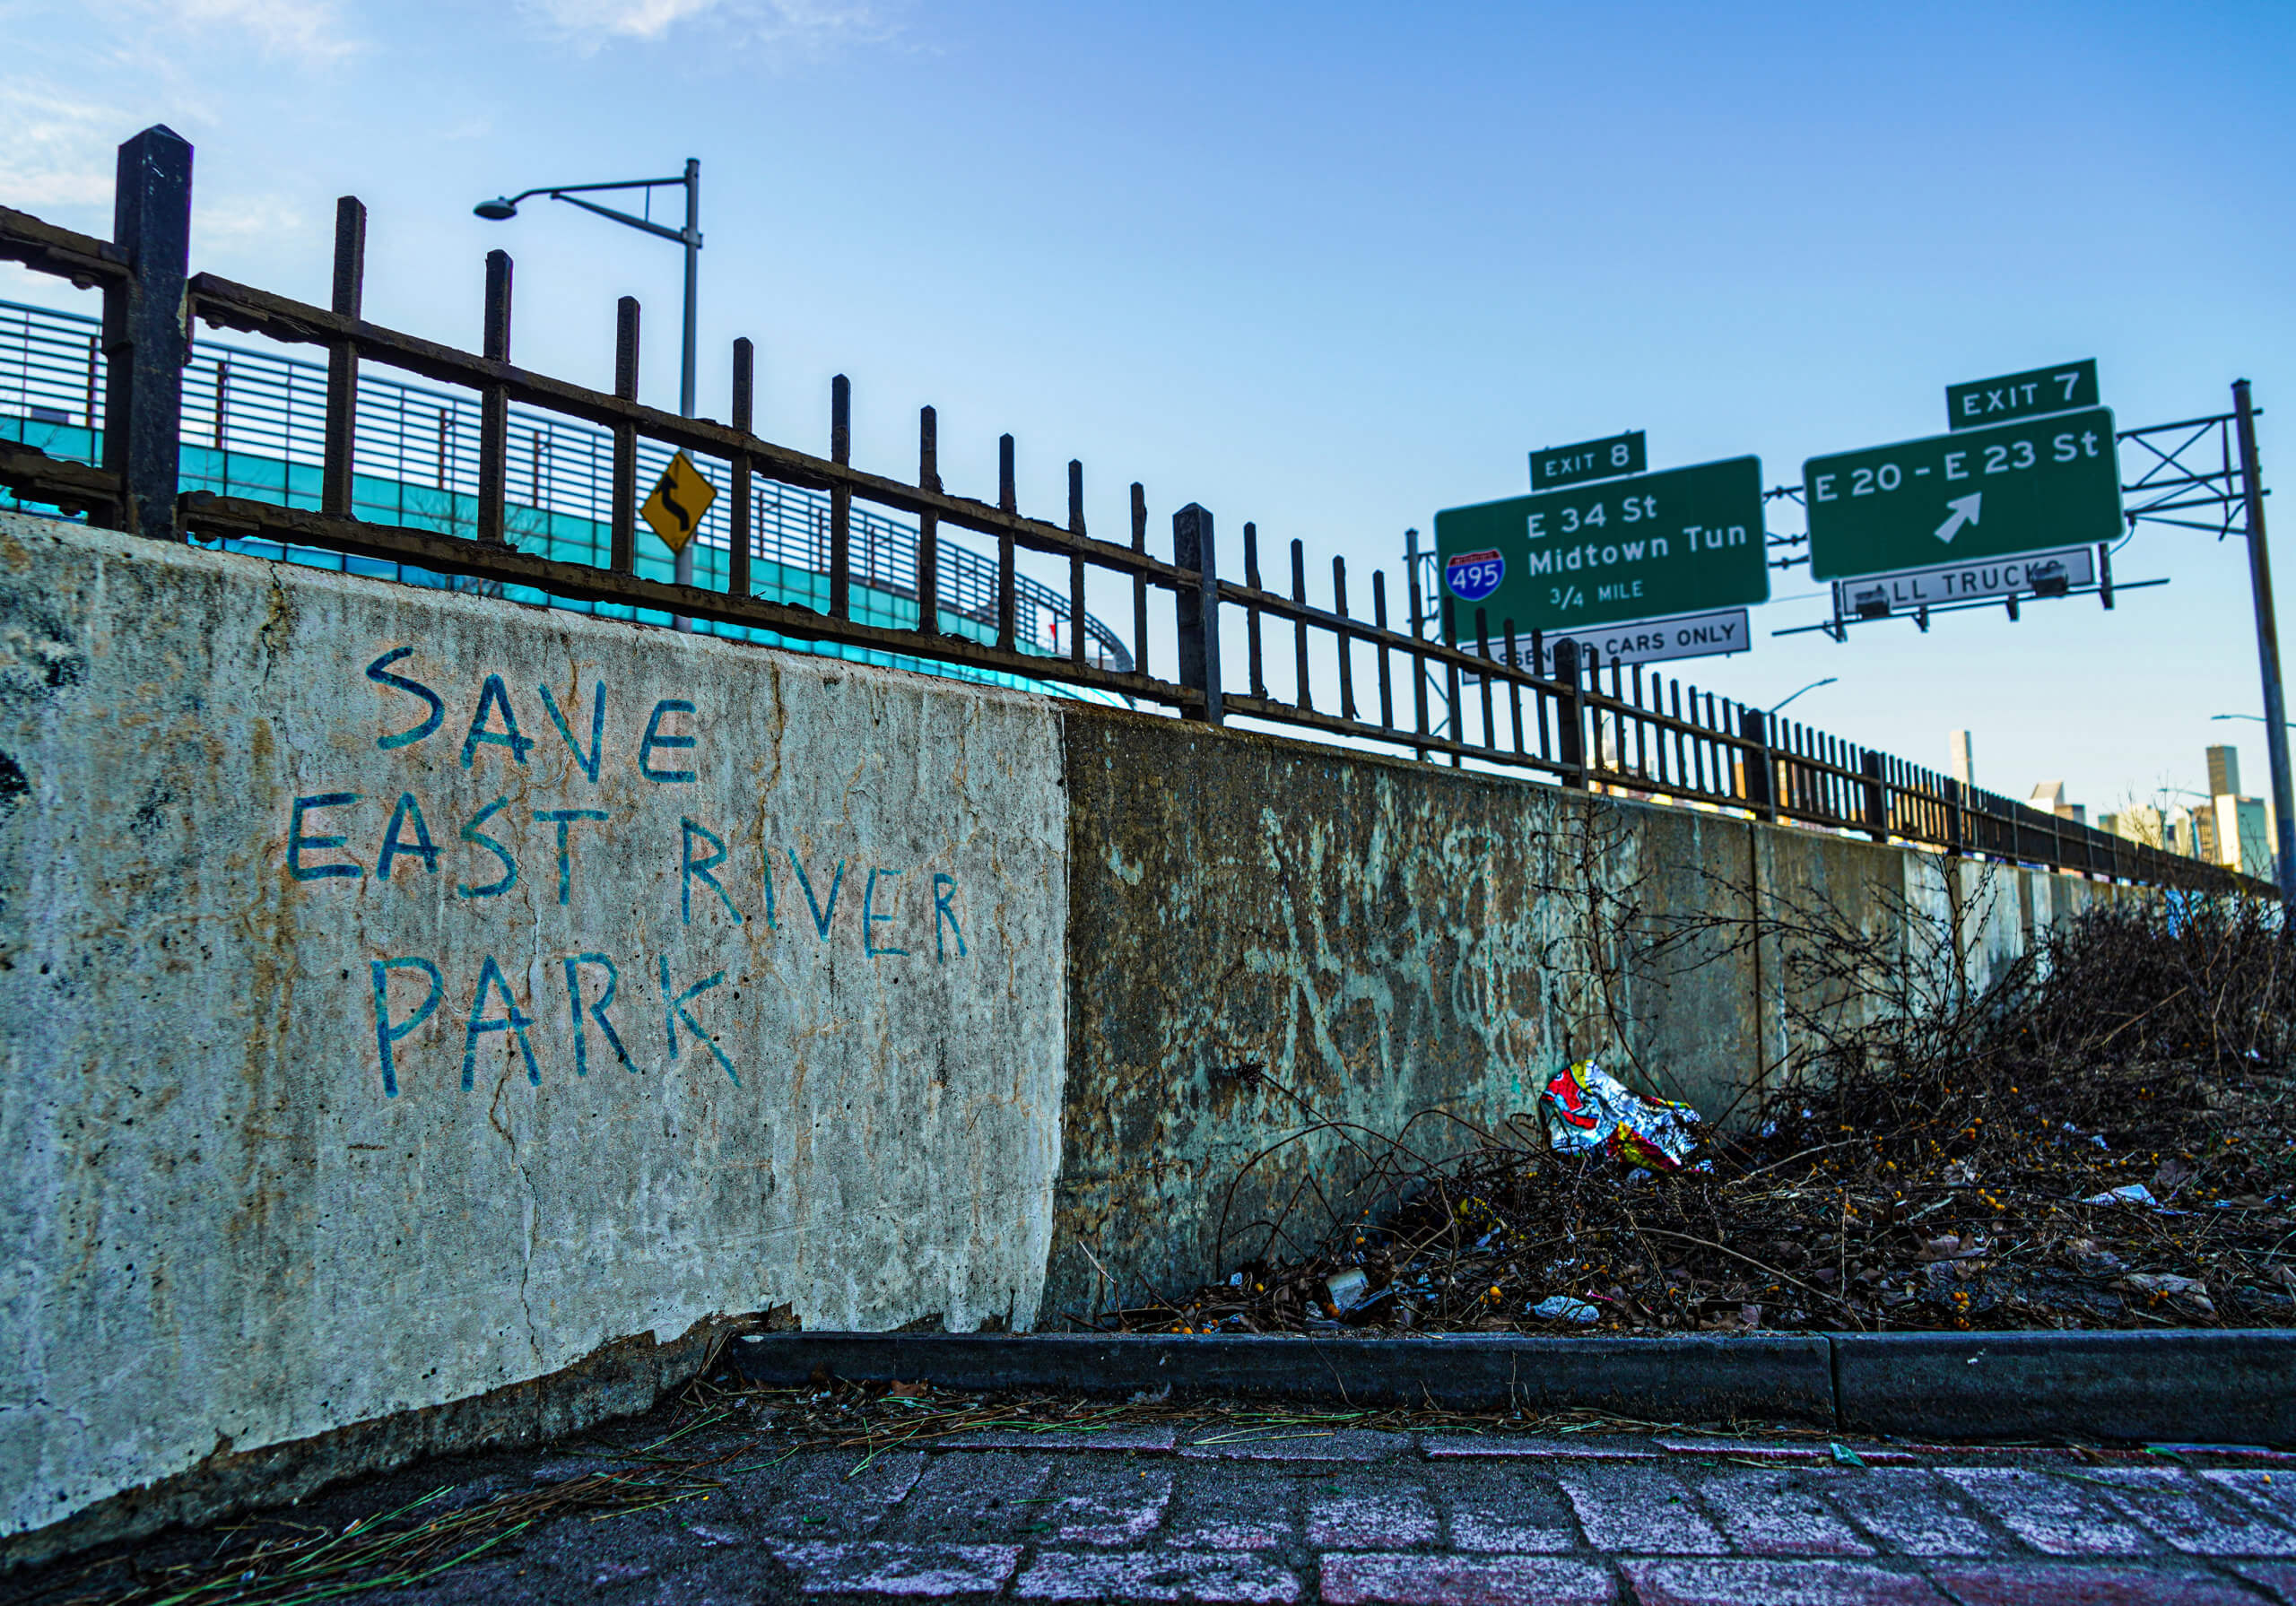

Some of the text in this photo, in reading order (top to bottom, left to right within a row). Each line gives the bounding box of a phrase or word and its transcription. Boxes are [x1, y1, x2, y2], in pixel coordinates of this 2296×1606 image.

[1962, 372, 2080, 416] EXIT 7
[1544, 443, 1631, 478] EXIT 8
[1815, 474, 1838, 502] E
[1851, 464, 1901, 496] 20
[1944, 452, 1969, 481] E
[1984, 441, 2036, 474] 23
[2053, 430, 2099, 462] St
[1527, 494, 1658, 539] E 34 St
[1528, 535, 1669, 577] Midtown
[1683, 525, 1747, 552] Tun
[1452, 563, 1499, 589] 495
[1597, 580, 1644, 602] MILE
[1871, 578, 1928, 605] LL
[1605, 632, 1665, 655] CARS
[1676, 622, 1736, 647] ONLY
[364, 646, 699, 785] SAVE
[287, 791, 969, 964] EAST RIVER
[370, 951, 744, 1099] PARK
